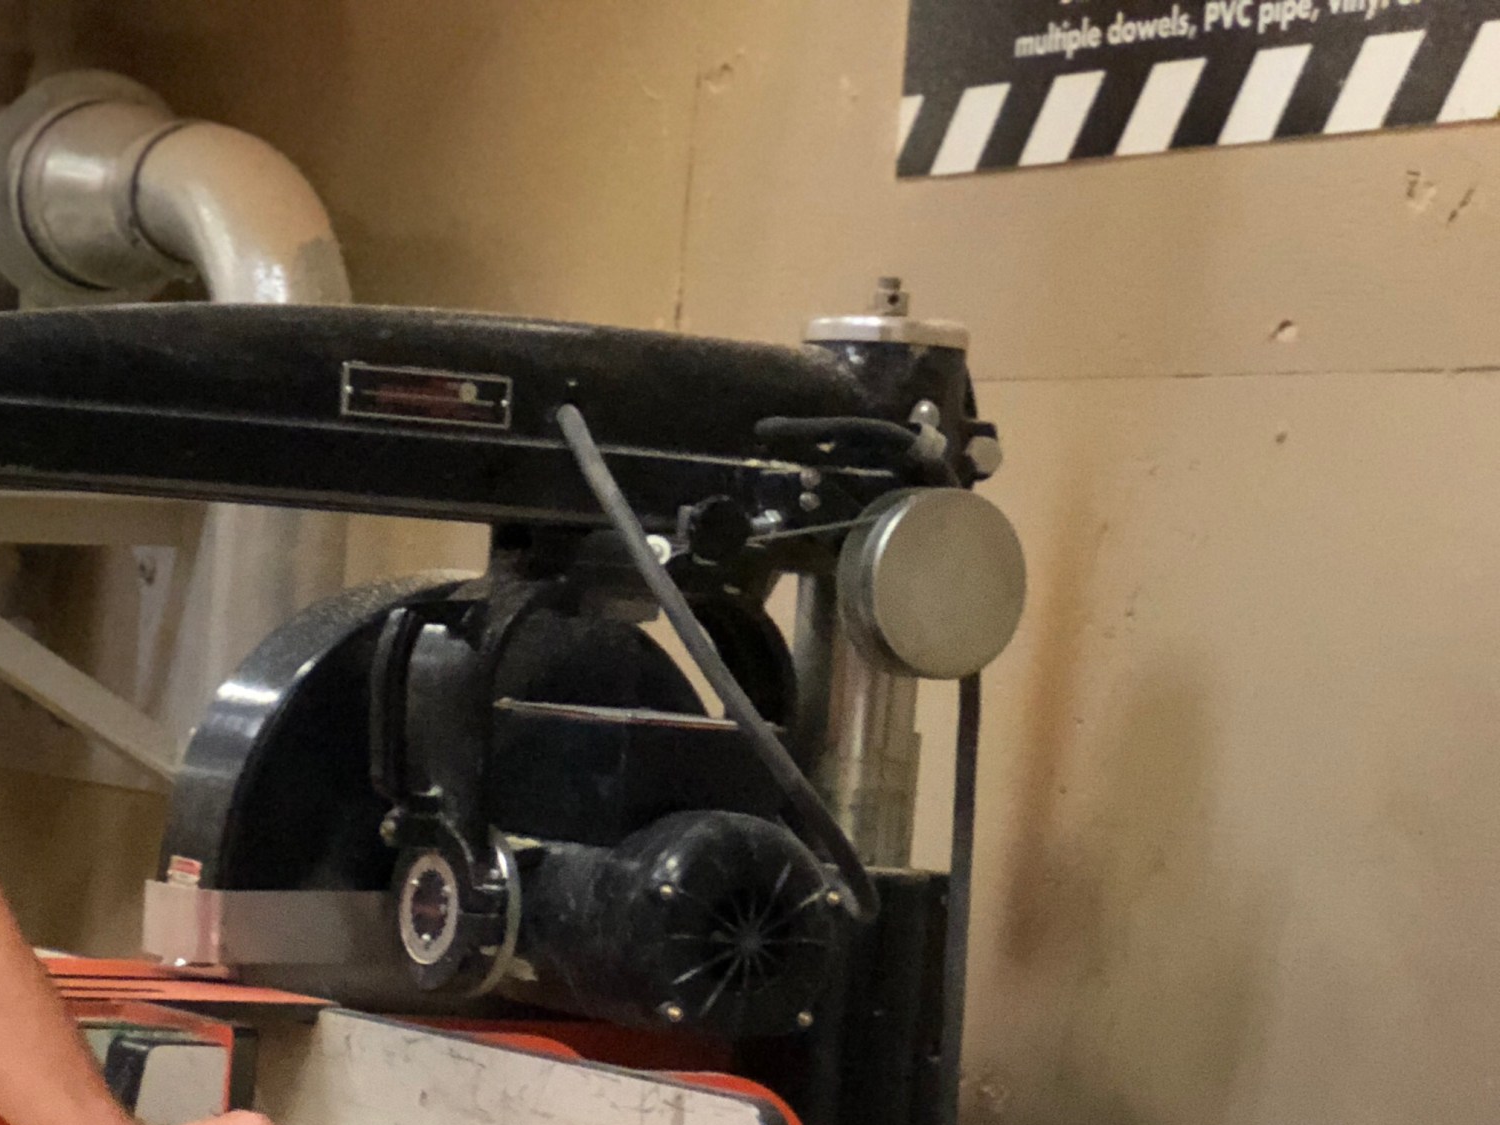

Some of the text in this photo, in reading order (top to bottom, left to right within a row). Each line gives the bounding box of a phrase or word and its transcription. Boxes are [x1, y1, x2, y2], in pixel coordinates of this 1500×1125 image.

[1014, 15, 1101, 60] multiple
[1106, 3, 1198, 45] dowels,
[1203, 0, 1252, 32] PVC
